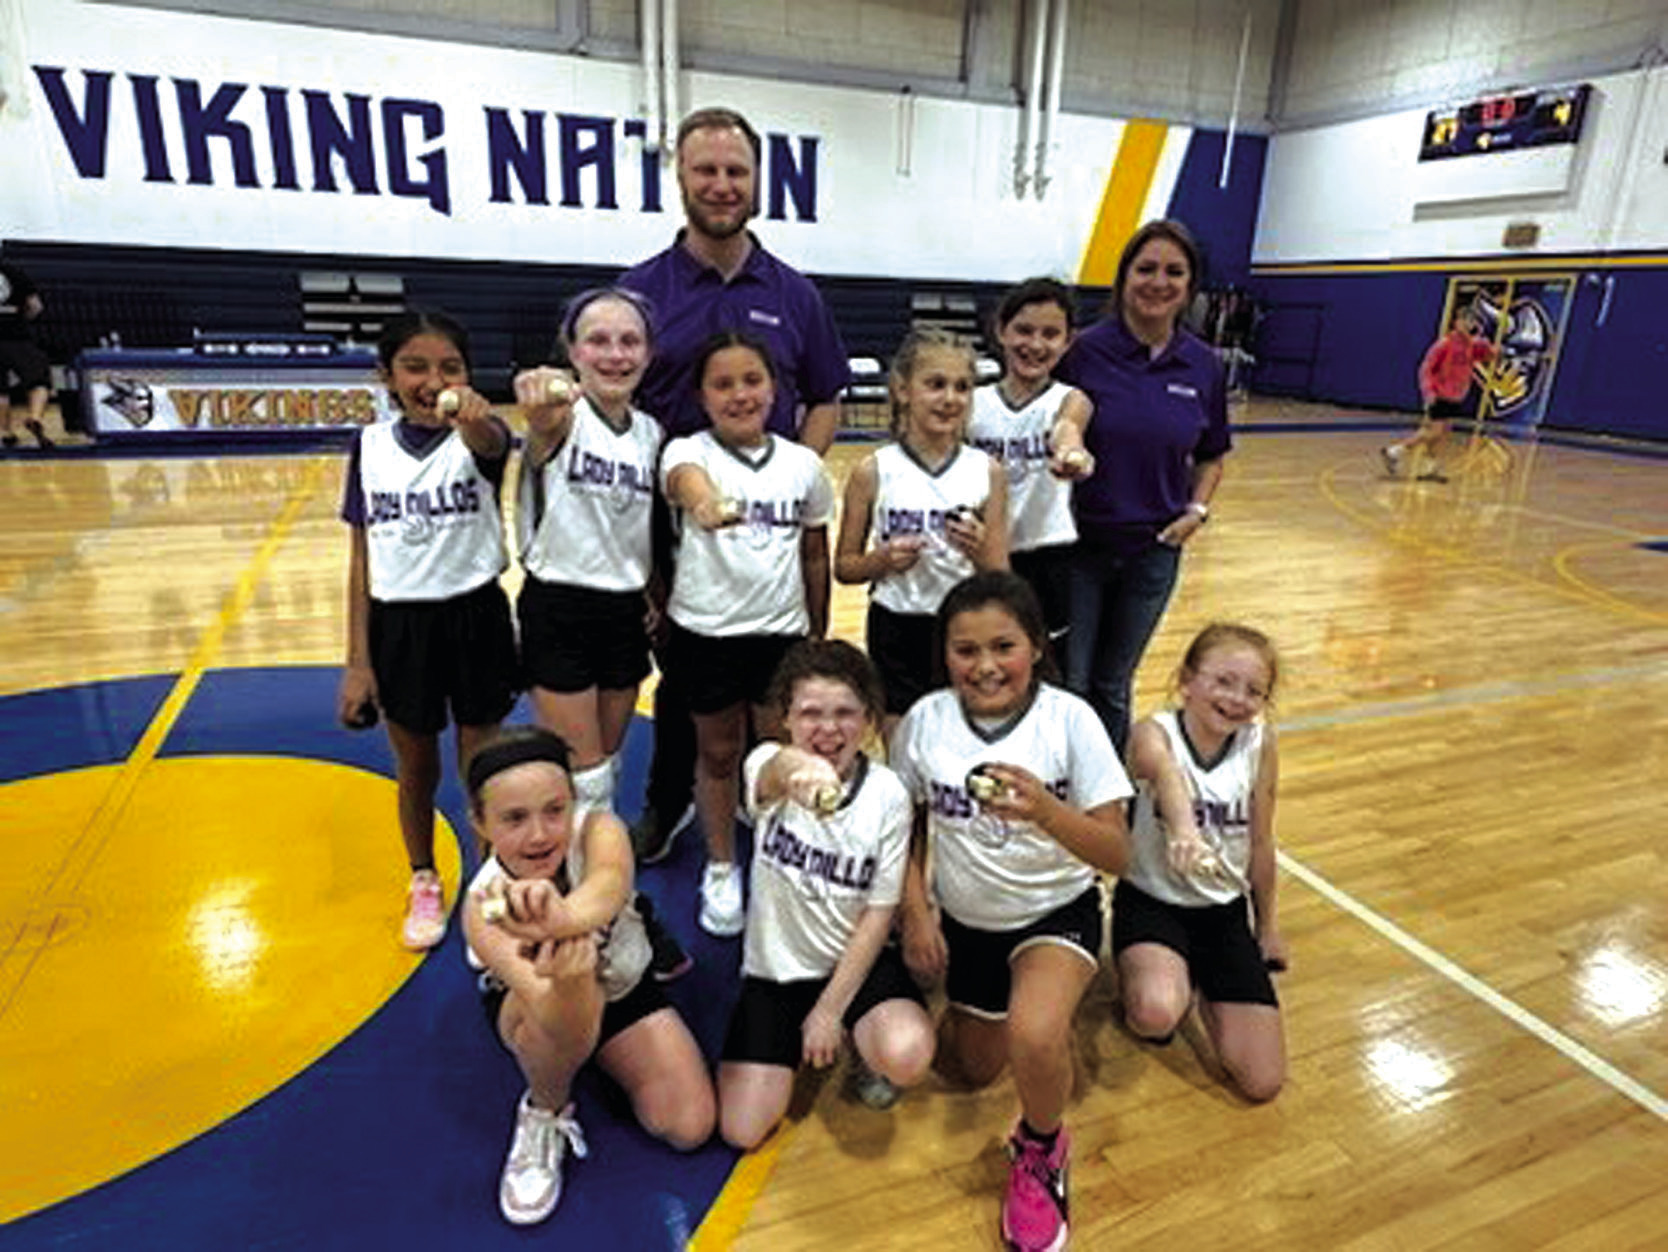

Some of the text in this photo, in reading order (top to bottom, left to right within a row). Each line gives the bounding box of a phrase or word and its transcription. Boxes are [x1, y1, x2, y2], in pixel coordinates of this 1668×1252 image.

[31, 64, 820, 223] VIKING NATN
[167, 388, 377, 425] VIKINGS
